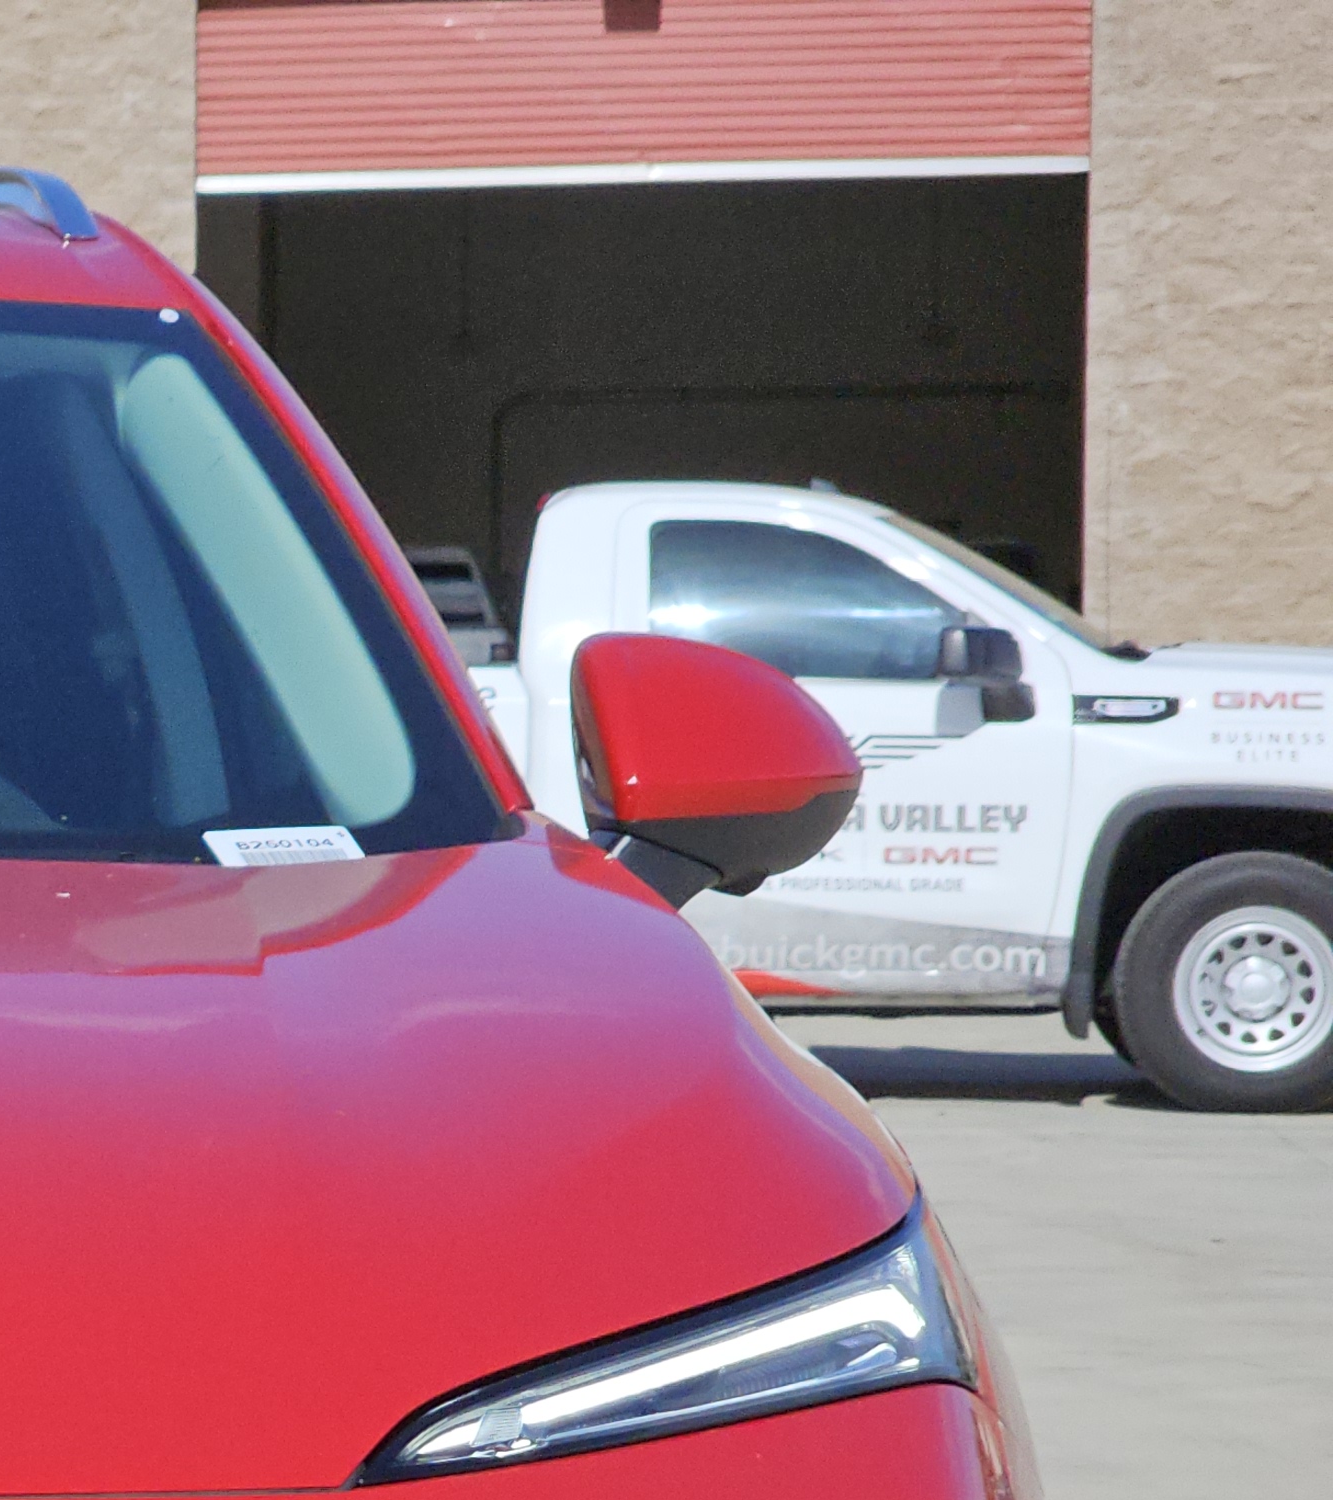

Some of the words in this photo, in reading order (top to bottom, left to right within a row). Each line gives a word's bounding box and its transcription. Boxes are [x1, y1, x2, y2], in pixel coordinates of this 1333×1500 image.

[1213, 690, 1324, 710] GMC
[1211, 732, 1325, 745] BUSINESS
[1236, 749, 1299, 762] ELITE
[879, 804, 1027, 833] VALLEY
[883, 846, 998, 866] GMC
[710, 933, 1047, 979] buickgmc.com
